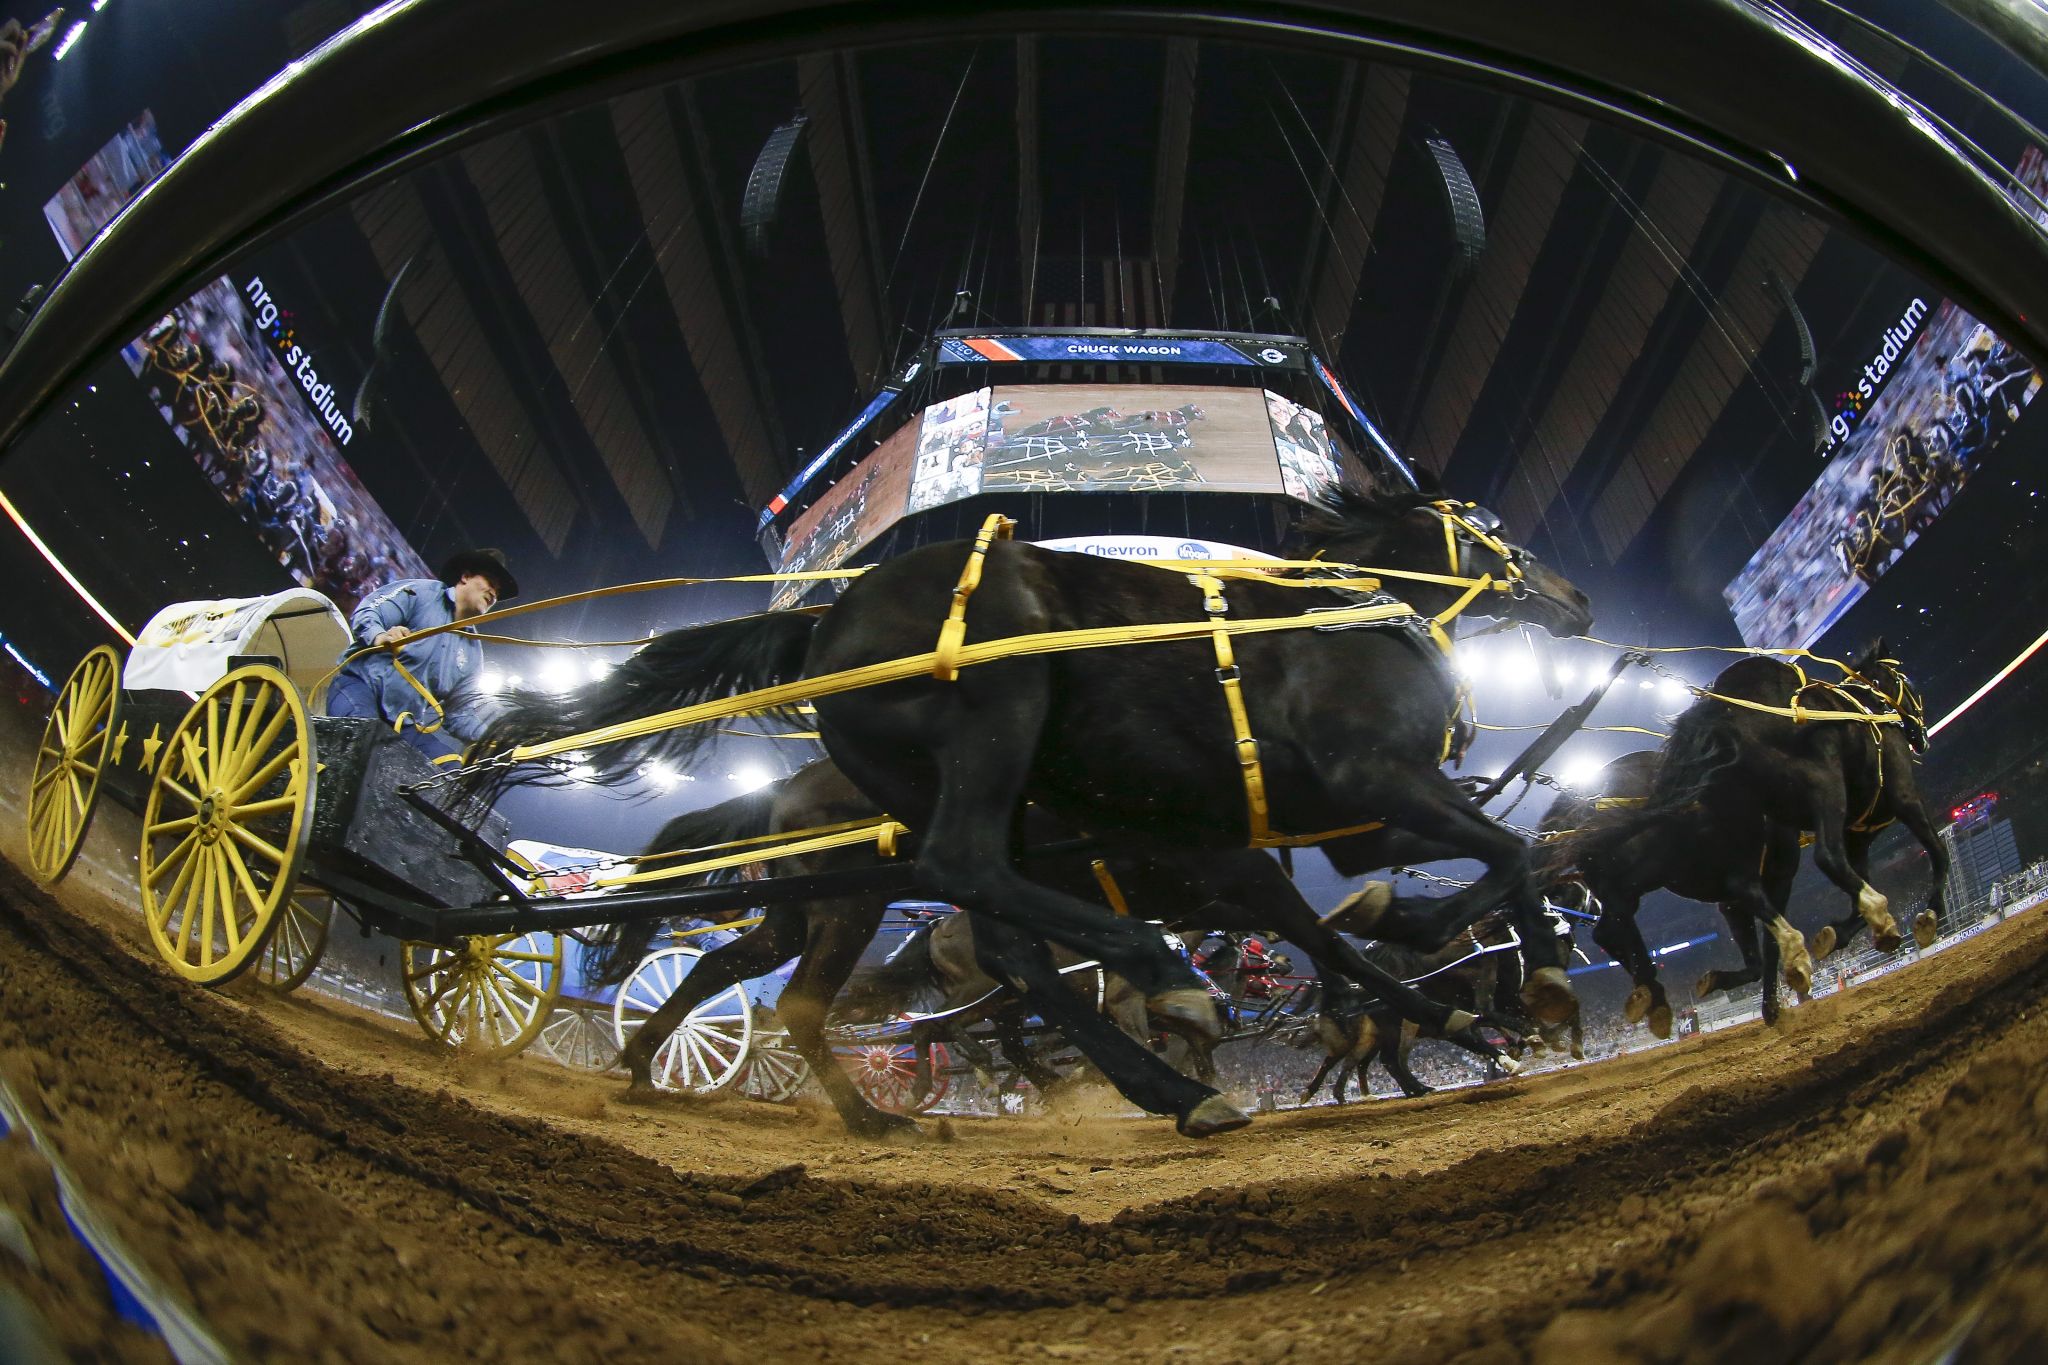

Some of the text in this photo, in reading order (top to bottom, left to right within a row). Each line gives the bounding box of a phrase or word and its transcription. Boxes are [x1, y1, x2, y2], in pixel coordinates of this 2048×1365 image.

[246, 276, 353, 445] nrg stadium
[1067, 344, 1181, 355] CHUCK WAGON
[1858, 298, 1928, 399] stadium
[1084, 544, 1158, 557] Chevron
